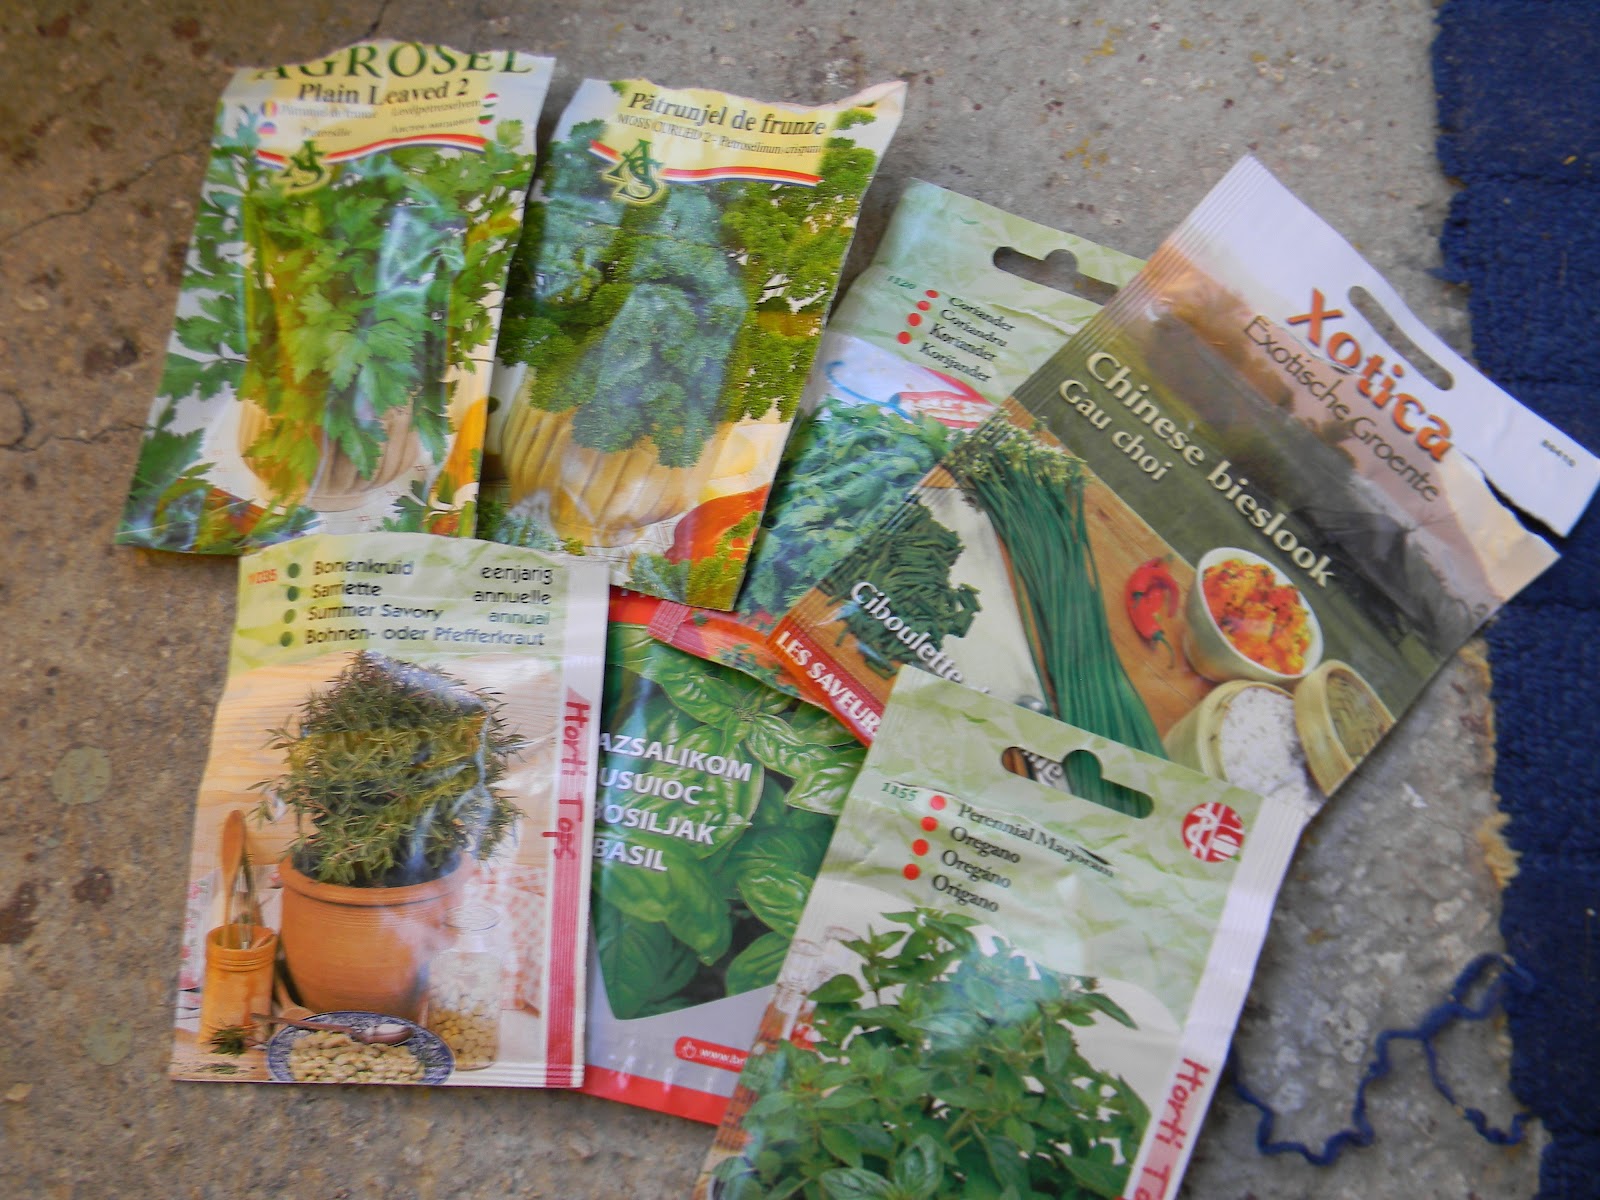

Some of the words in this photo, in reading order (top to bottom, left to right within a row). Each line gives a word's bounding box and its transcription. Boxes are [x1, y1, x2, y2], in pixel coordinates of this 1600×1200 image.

[299, 83, 359, 104] Plain
[368, 80, 450, 106] Leaved
[456, 77, 470, 96] 2
[618, 113, 650, 129] MOSS
[651, 121, 702, 140] CURLED
[731, 109, 756, 131] de
[760, 113, 827, 135] frunze
[941, 309, 1008, 347] Coriandru
[949, 297, 1016, 332] Coriander
[929, 323, 998, 362] Koriander
[919, 341, 992, 383] Korijander
[1287, 287, 1454, 463] Xotica
[1244, 316, 1351, 421] Exotische
[1350, 415, 1441, 503] Groente
[1059, 379, 1112, 430] Gau
[1111, 431, 1173, 481] choi
[1086, 351, 1205, 466] Chinese
[1206, 459, 1336, 588] bieslook
[313, 559, 414, 576] Bonenkruid
[481, 565, 553, 585] eenjarig
[308, 605, 376, 621] Summer
[380, 603, 444, 621] Savory
[488, 612, 551, 625] annual
[472, 589, 552, 605] annuelle
[305, 627, 377, 645] Bohnen-
[383, 625, 429, 641] oder
[433, 626, 545, 646] Pfefferkraut
[775, 630, 813, 666] LES
[851, 581, 963, 683] Ciboulette
[561, 700, 592, 777] Horti
[881, 782, 919, 801] 1155
[958, 803, 1035, 841] Perennial
[592, 837, 668, 872] BASIL
[950, 826, 1021, 863] Oregano
[932, 874, 999, 912] Origano
[1155, 1057, 1210, 1149] Horti
